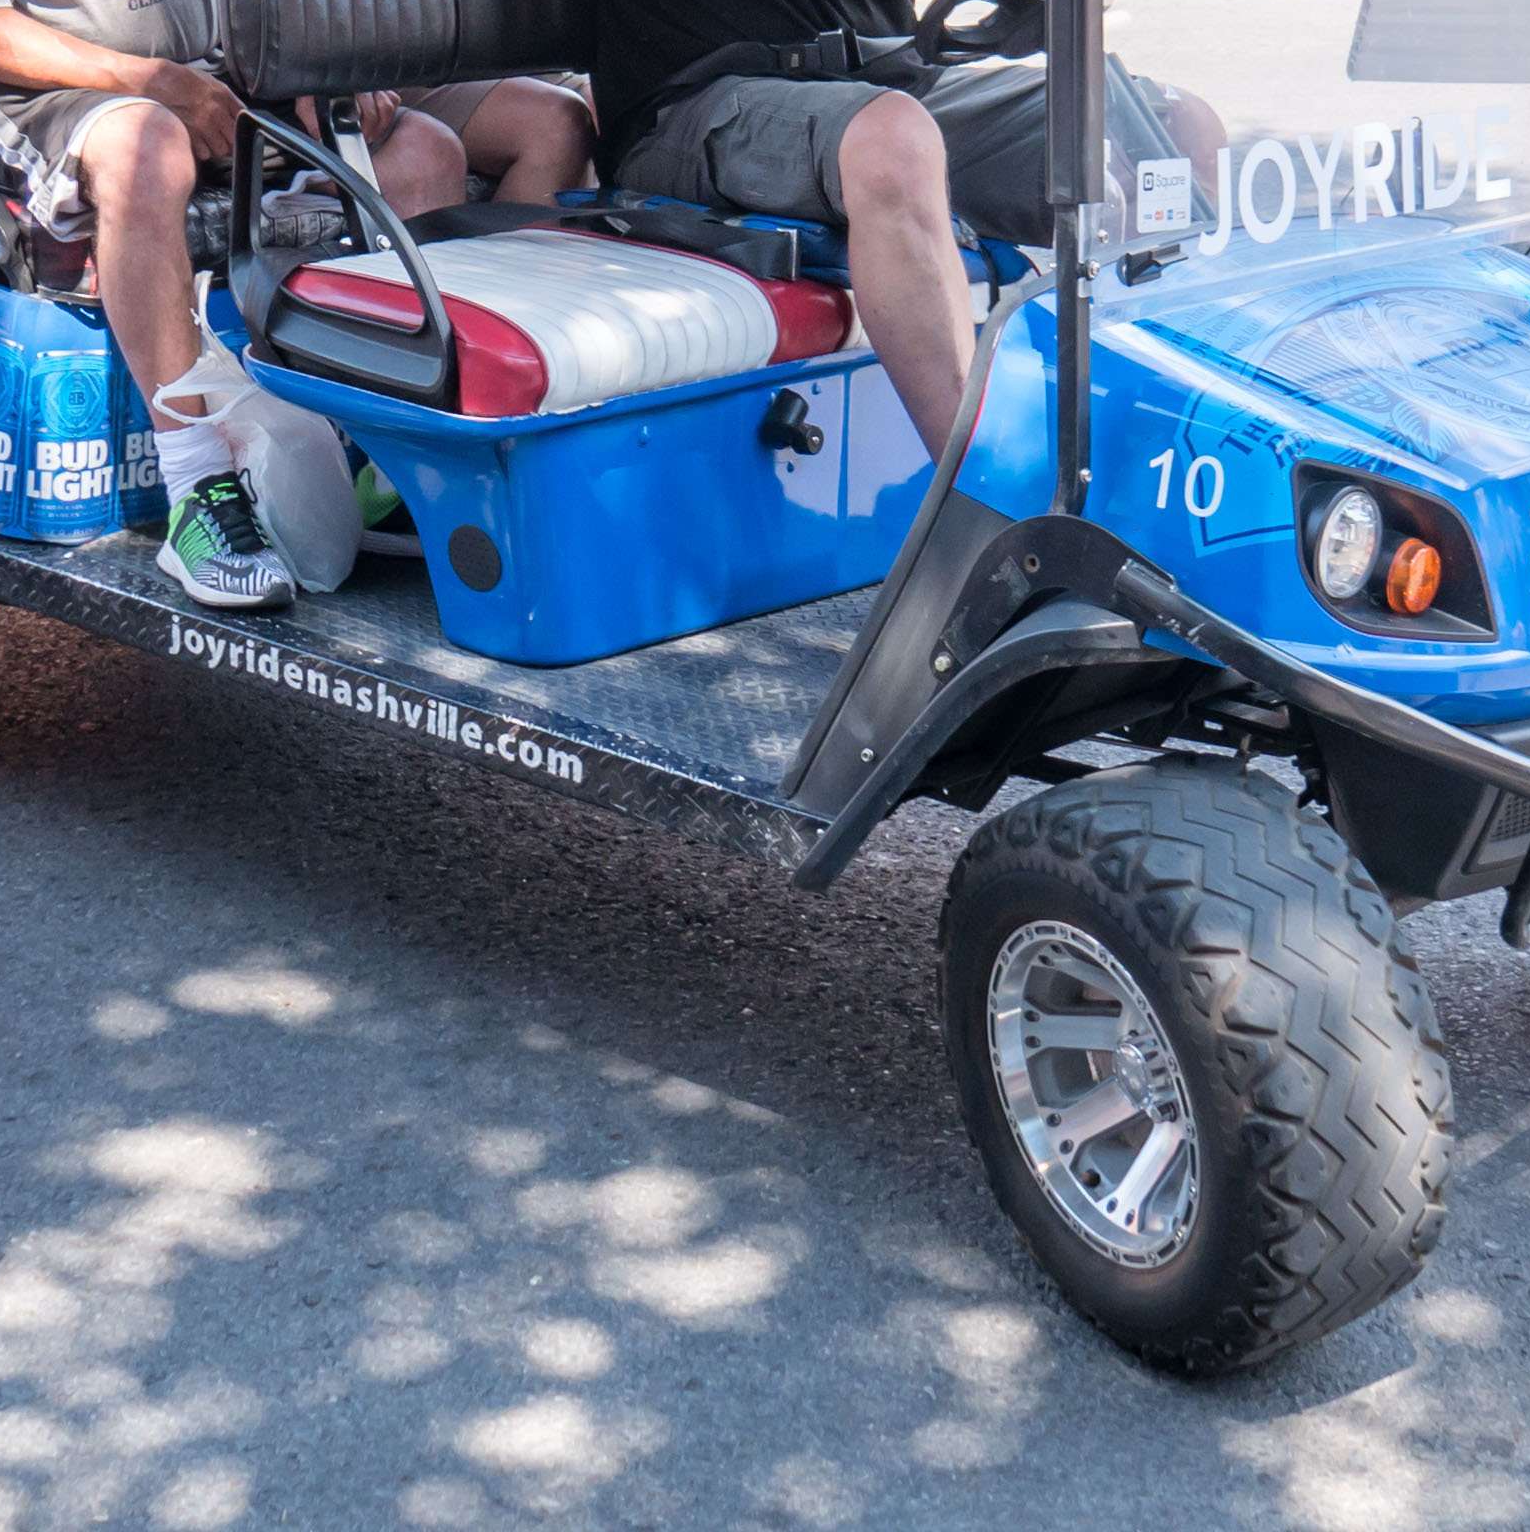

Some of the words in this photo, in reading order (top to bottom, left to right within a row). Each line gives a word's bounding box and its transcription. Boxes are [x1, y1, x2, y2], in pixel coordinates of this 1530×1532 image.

[1198, 106, 1511, 256] JOYRIDE
[37, 439, 109, 470] BUD
[125, 429, 160, 461] BU
[27, 465, 114, 501] LIGHT
[1149, 448, 1225, 518] 10
[168, 614, 583, 784] joyridenashville.com
